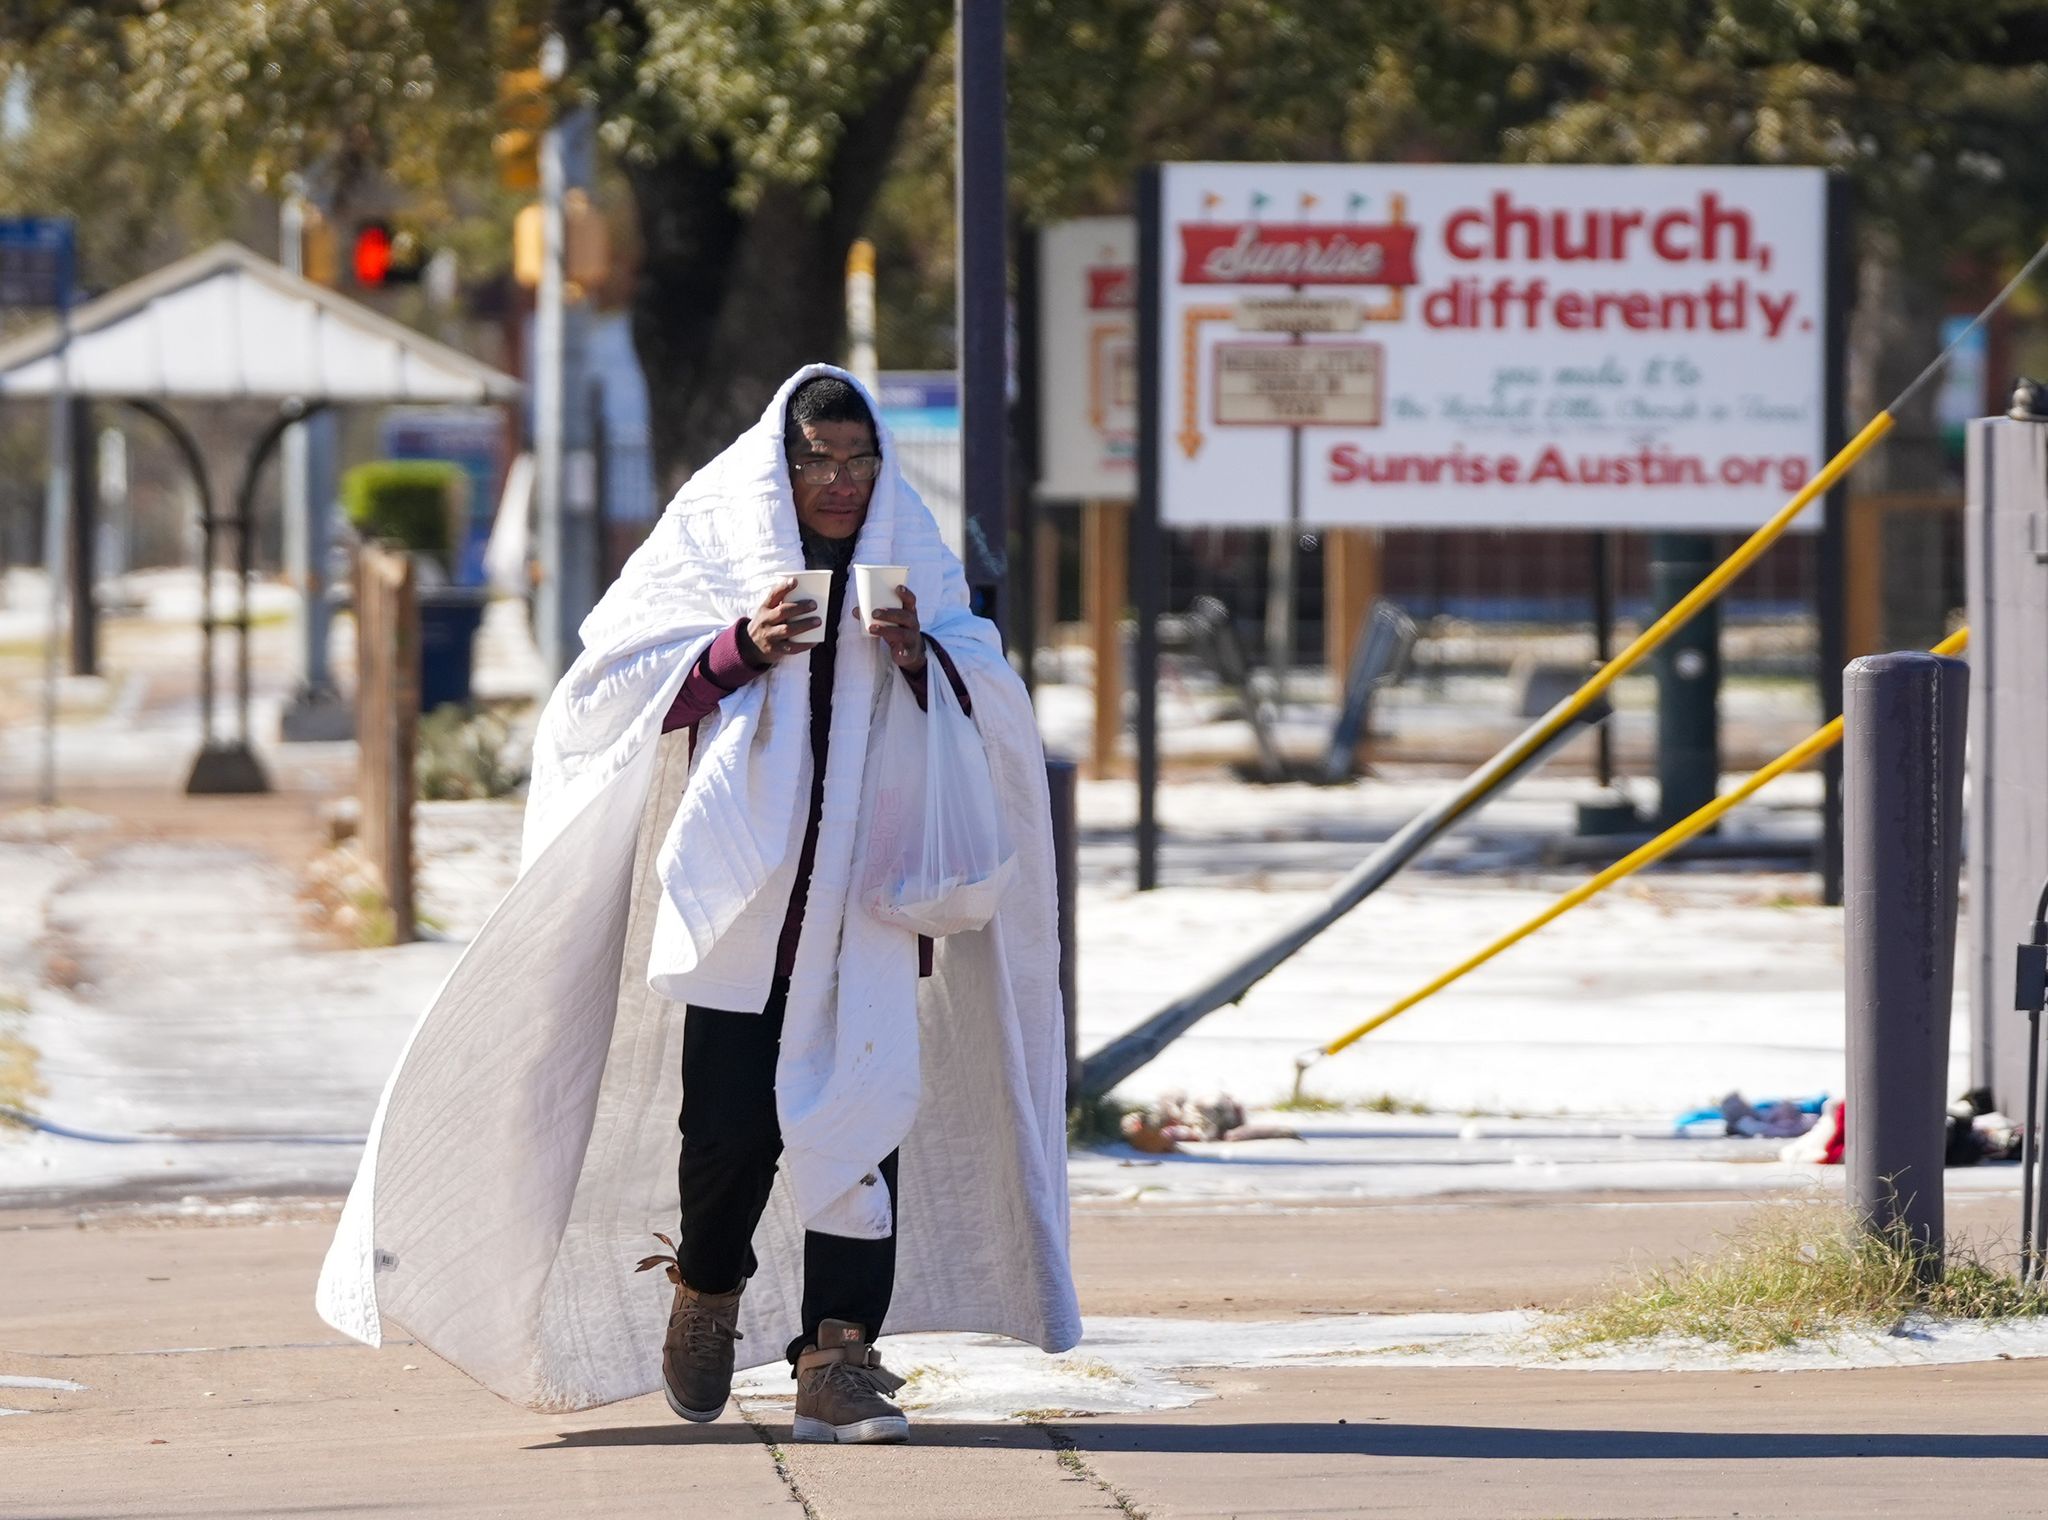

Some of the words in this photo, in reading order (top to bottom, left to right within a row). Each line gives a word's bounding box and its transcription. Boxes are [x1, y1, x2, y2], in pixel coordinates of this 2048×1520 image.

[1203, 223, 1385, 280] Sunrise
[1443, 191, 1771, 270] church,
[1422, 279, 1813, 338] differently.
[1329, 443, 1810, 492] SunriseAustin.org
